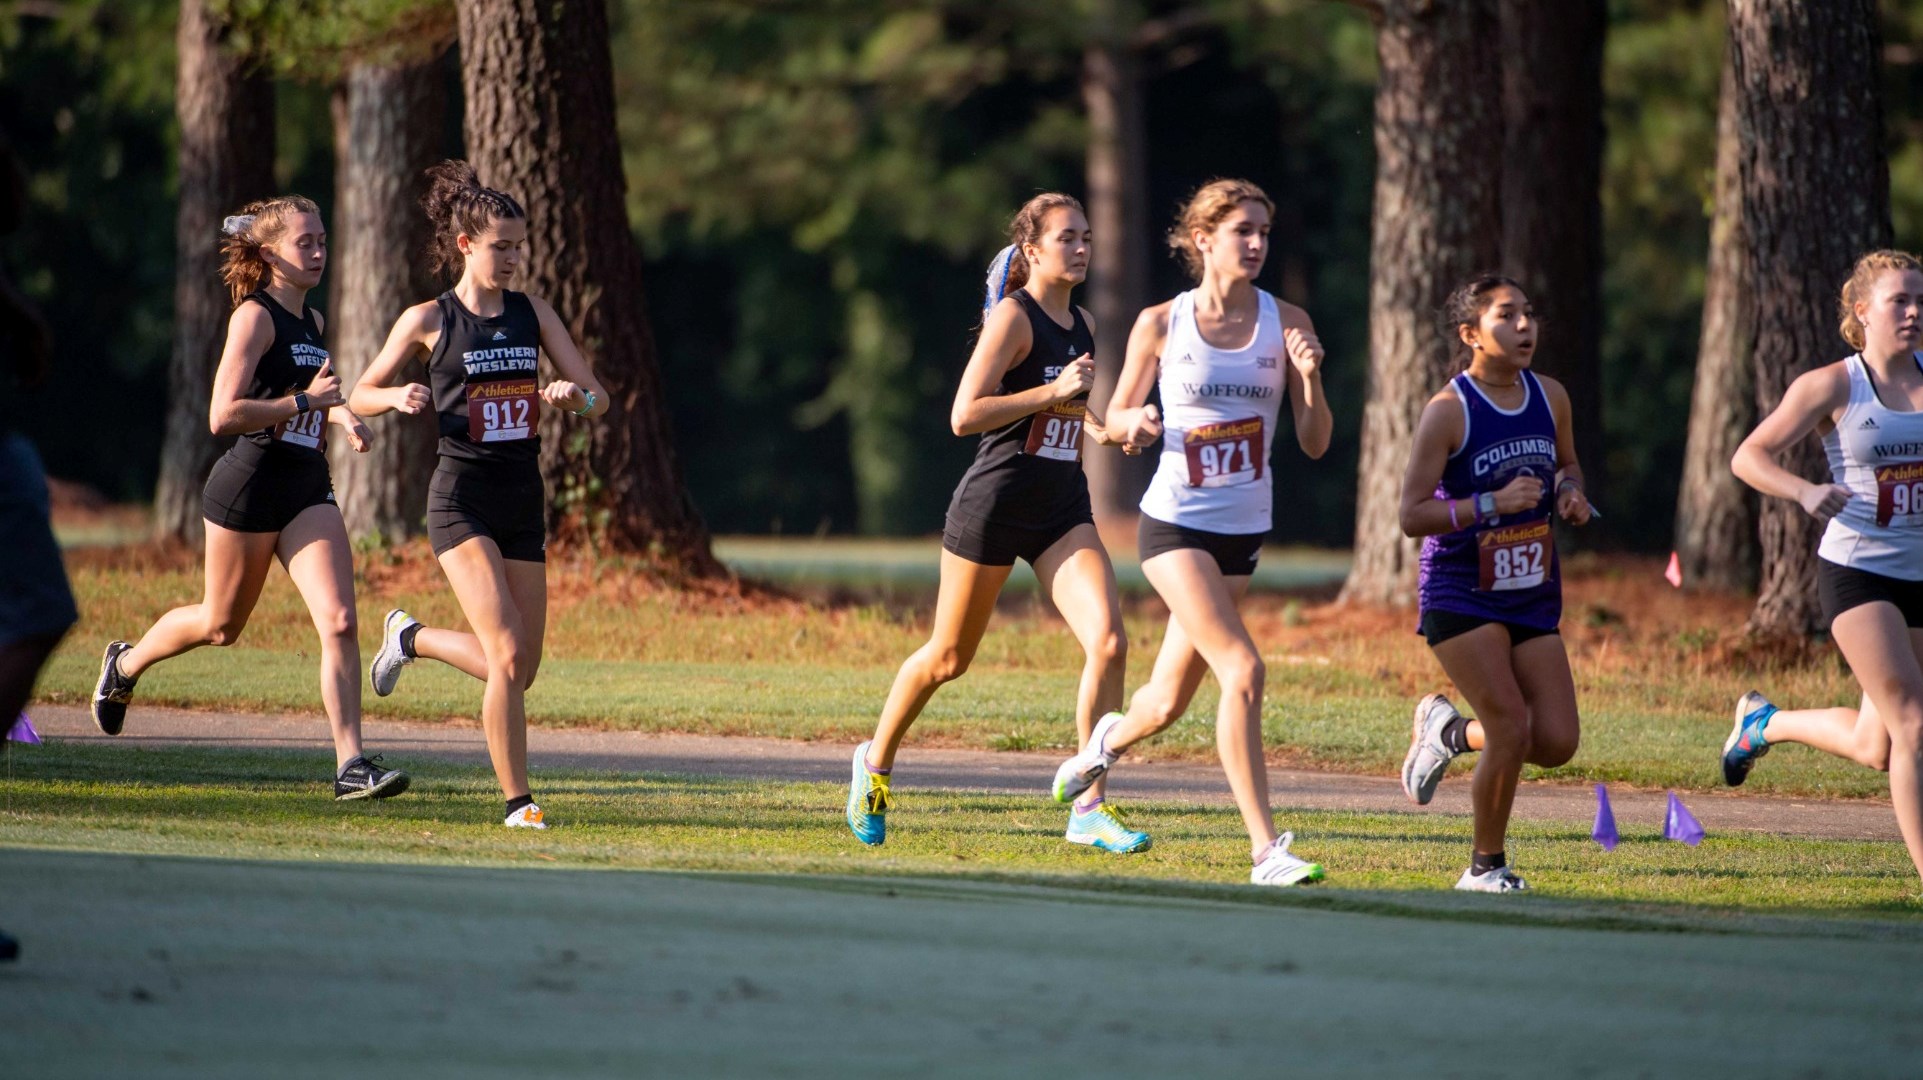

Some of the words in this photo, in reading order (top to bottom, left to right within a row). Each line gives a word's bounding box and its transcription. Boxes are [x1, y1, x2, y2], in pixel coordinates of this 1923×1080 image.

[463, 347, 537, 363] SOUTHERN
[464, 359, 537, 375] WESLEYAN
[1182, 383, 1274, 399] WOFFORD
[483, 399, 529, 430] 912
[1043, 418, 1081, 449] 917
[1200, 440, 1254, 477] 971
[1494, 542, 1544, 579] 852
